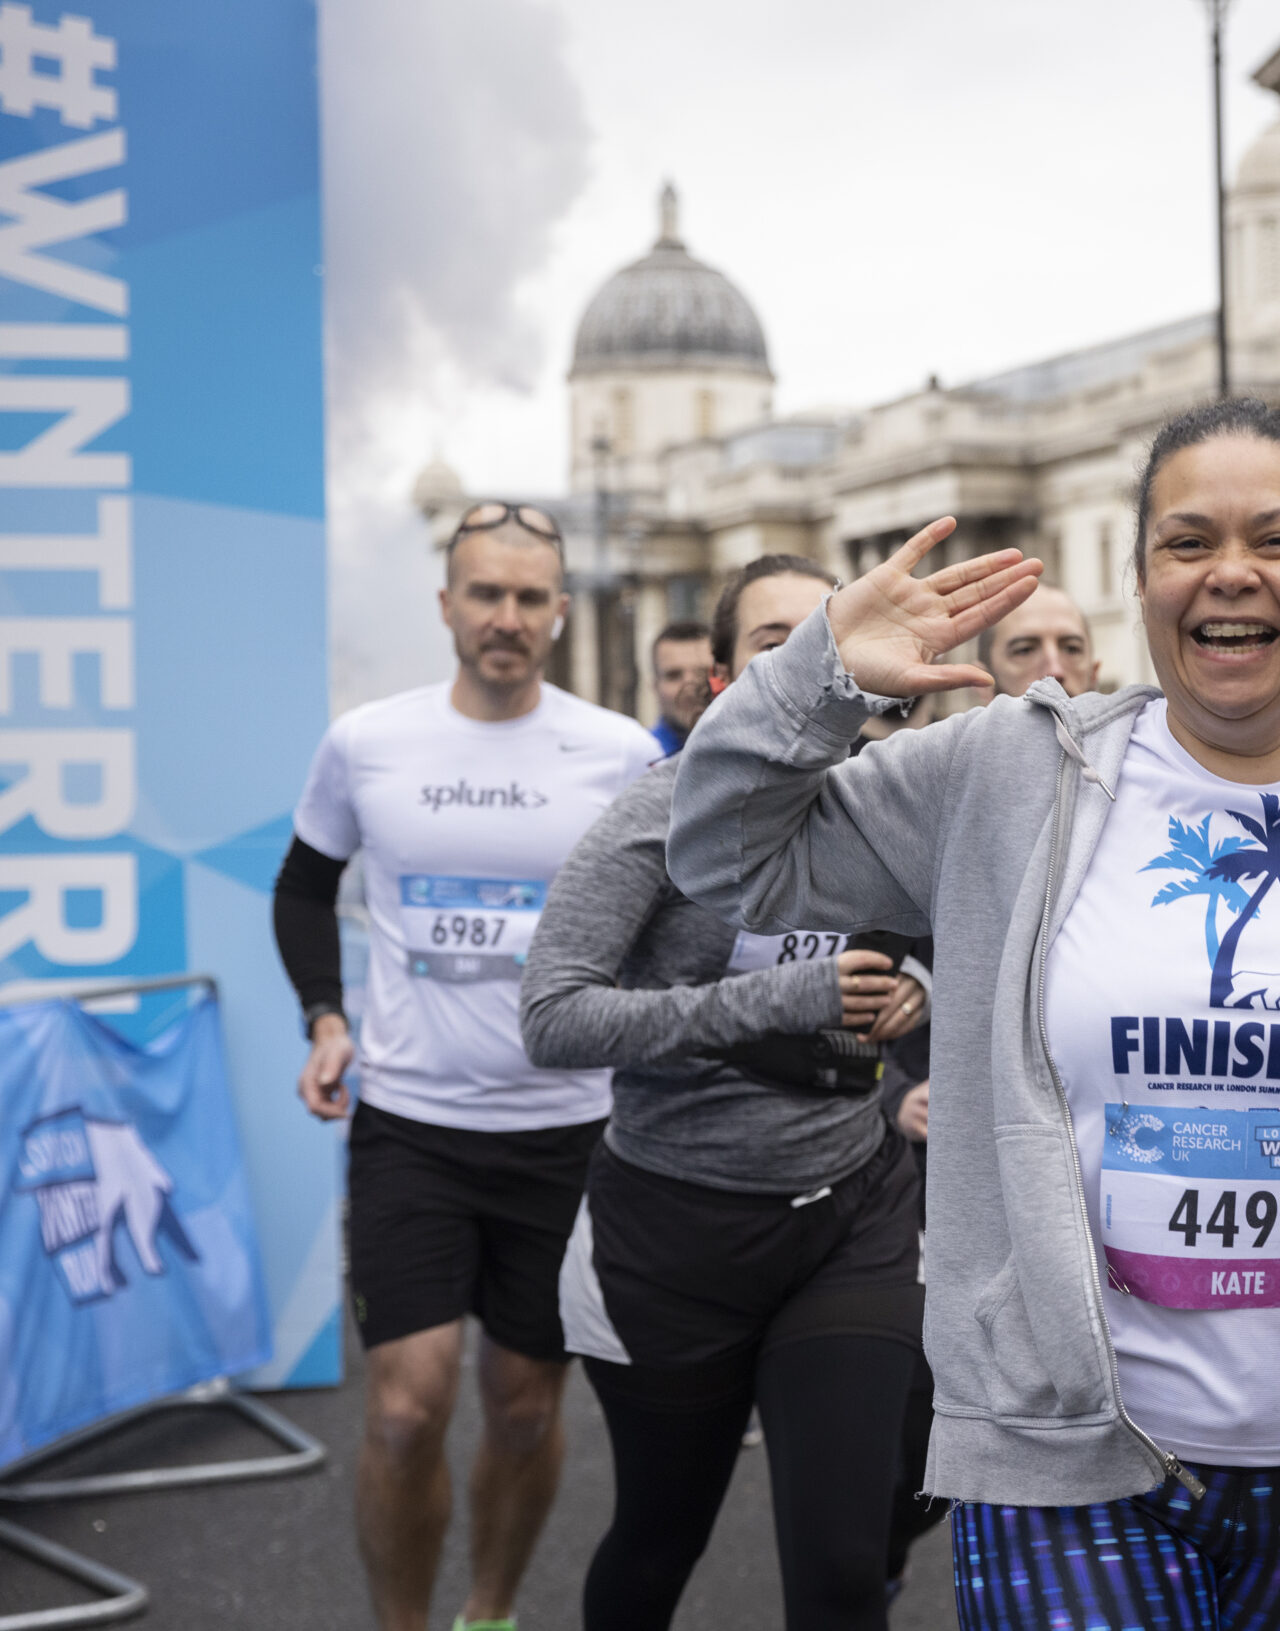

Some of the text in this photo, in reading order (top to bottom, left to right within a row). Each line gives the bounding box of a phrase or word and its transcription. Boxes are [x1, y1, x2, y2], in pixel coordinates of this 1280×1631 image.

[431, 915, 506, 947] 6987
[1147, 1082, 1176, 1091] CANCER
[1176, 1082, 1212, 1091] RESEARCH
[1213, 1083, 1225, 1092] UK
[1226, 1084, 1256, 1093] LONDON
[1172, 1121, 1228, 1136] CANCER
[1172, 1136, 1242, 1151] RESEARCH
[1172, 1150, 1190, 1162] UK
[1210, 1271, 1266, 1296] KATE
